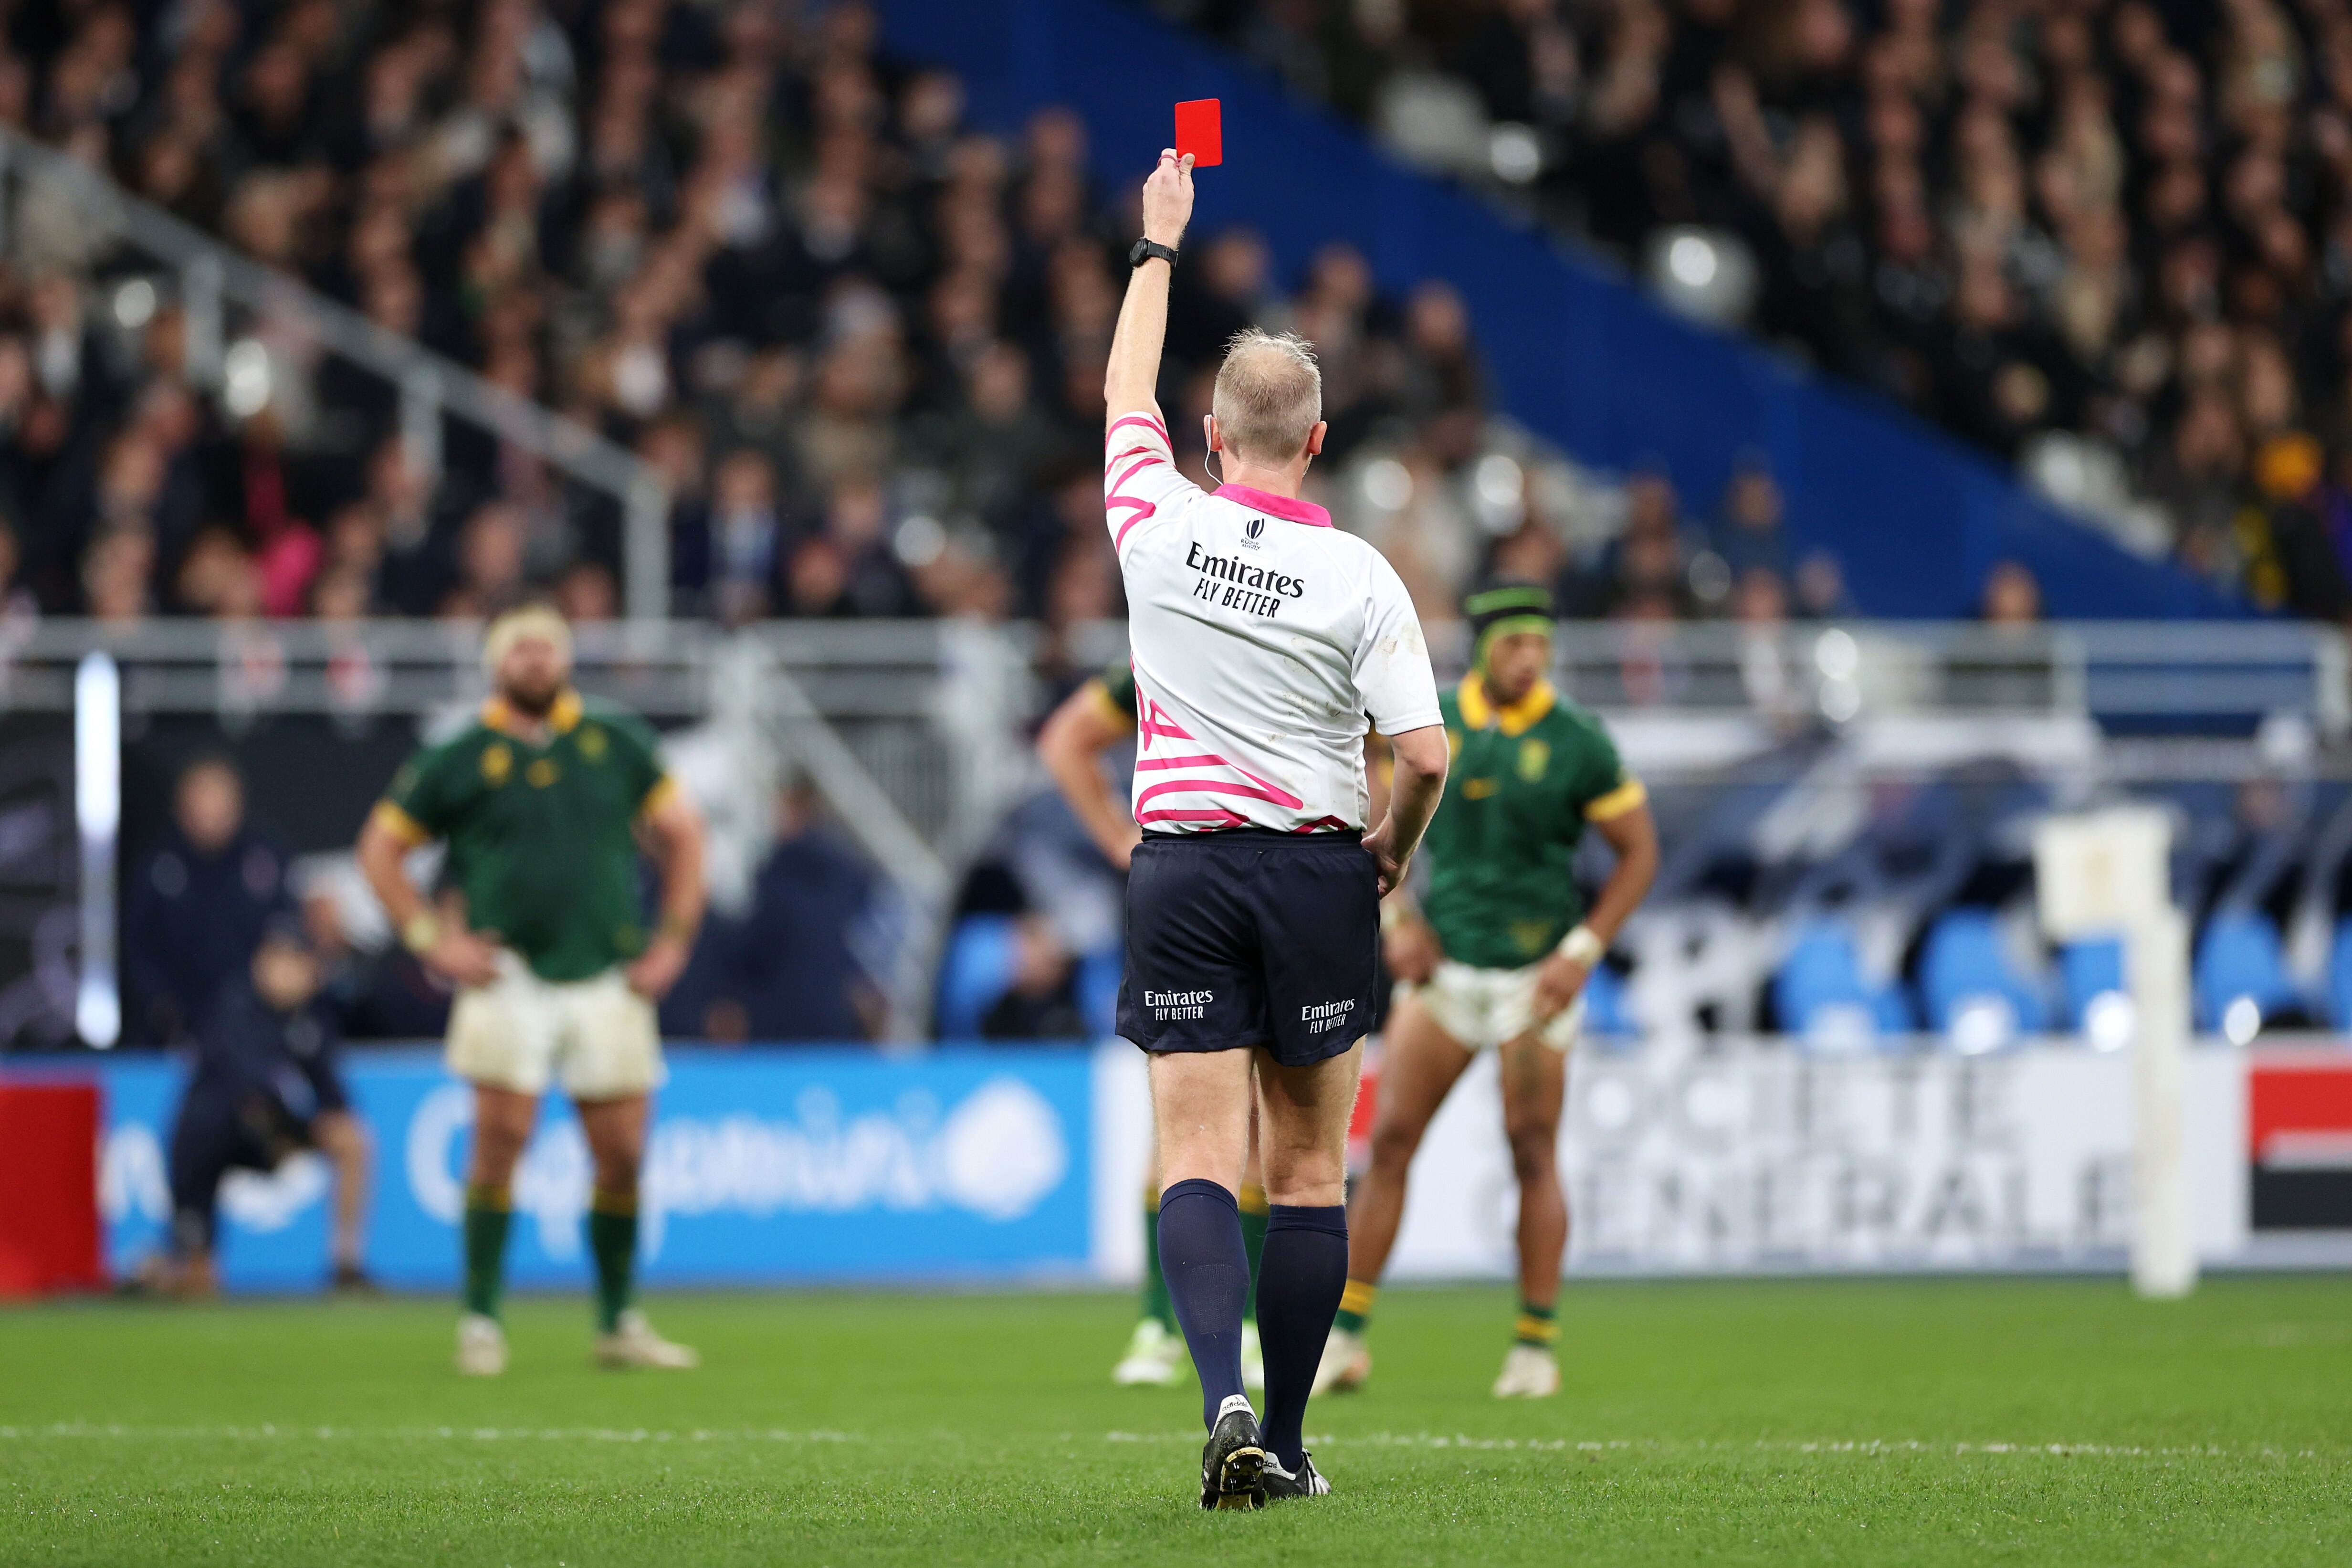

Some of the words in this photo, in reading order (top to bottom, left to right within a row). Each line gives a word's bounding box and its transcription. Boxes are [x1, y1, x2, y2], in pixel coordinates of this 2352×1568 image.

[1186, 541, 1304, 599] Emirates
[1193, 578, 1221, 602] FLY
[1221, 587, 1281, 618] BETTER
[1144, 989, 1213, 1007] Emirates
[1155, 1007, 1170, 1021] FLY
[1172, 1006, 1203, 1020] BETTER
[1302, 998, 1354, 1021] Emirates
[1310, 1020, 1323, 1034] FLY
[1325, 1014, 1346, 1031] BETTER
